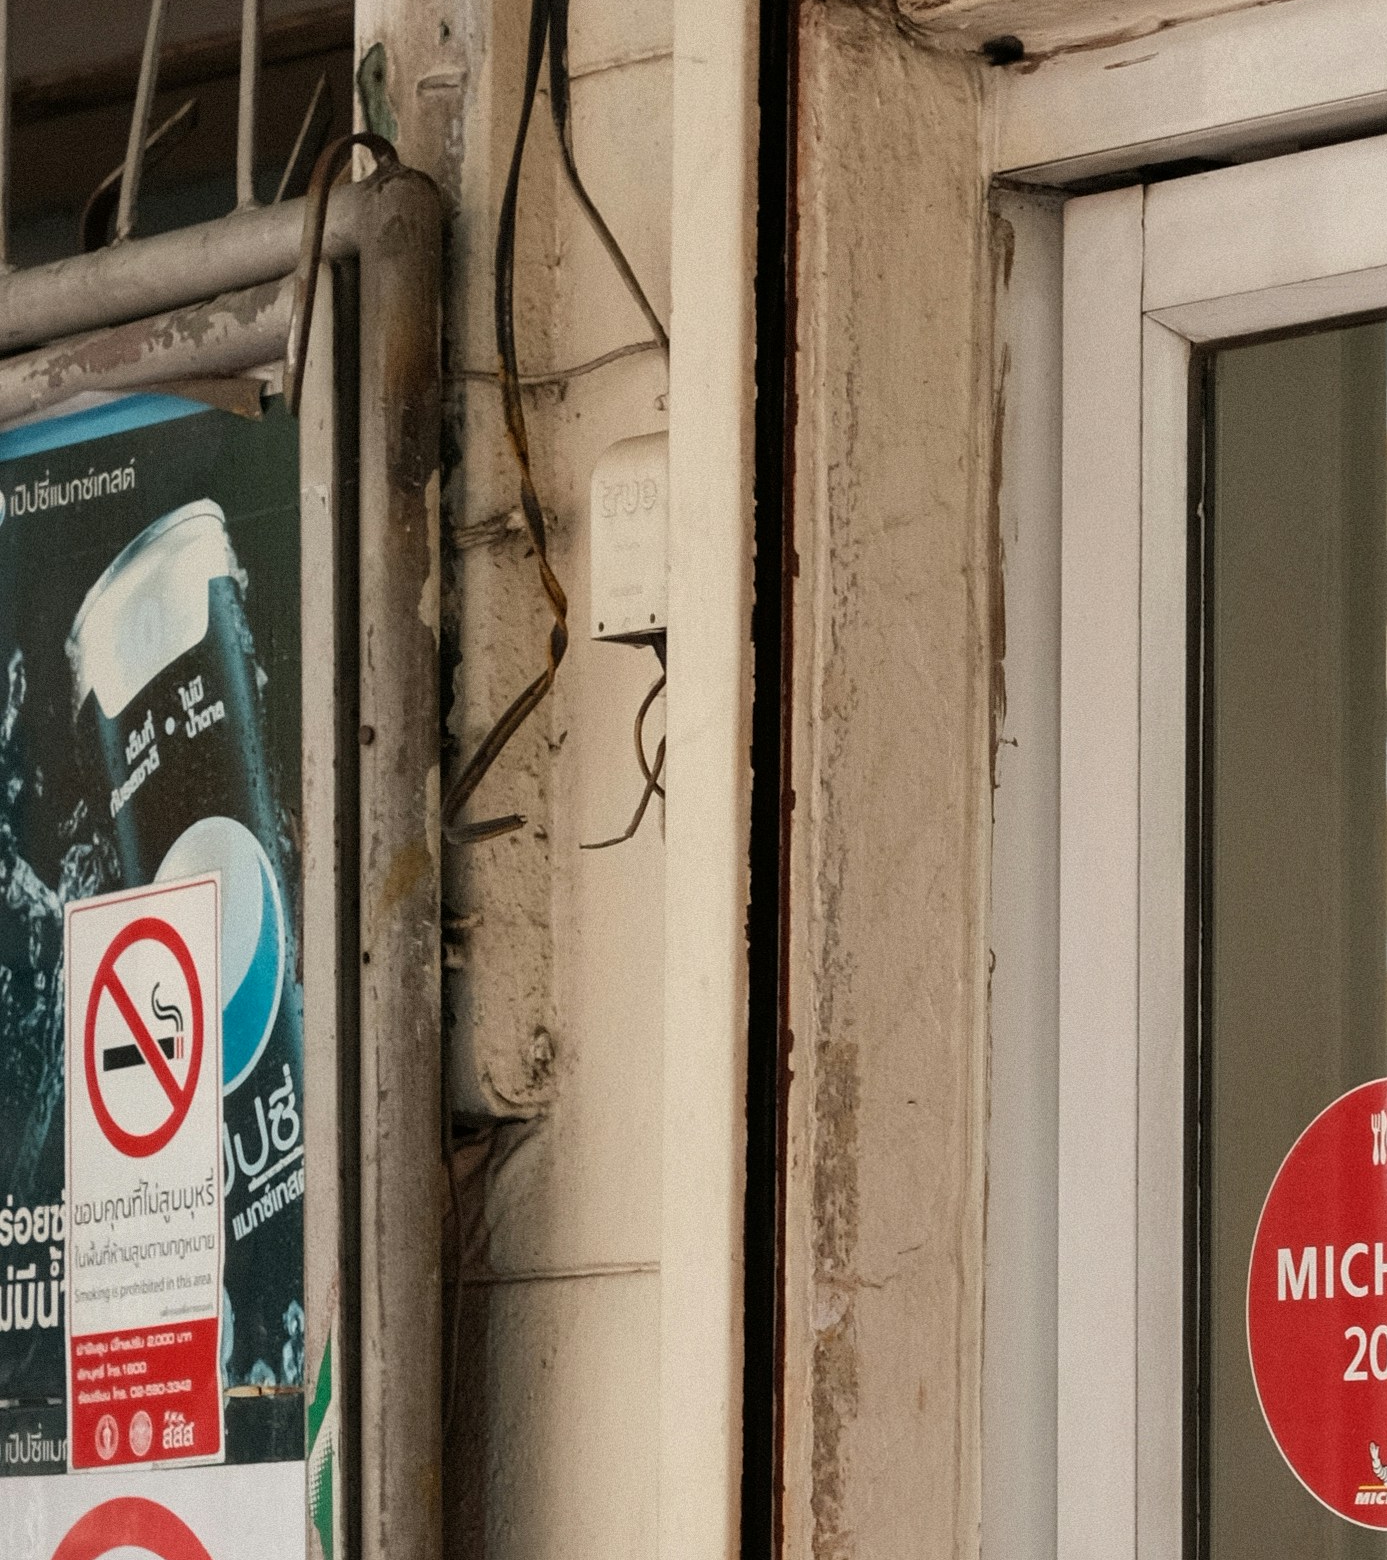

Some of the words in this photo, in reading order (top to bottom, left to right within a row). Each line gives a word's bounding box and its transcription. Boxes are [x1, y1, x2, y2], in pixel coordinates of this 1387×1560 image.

[74, 1168, 216, 1230] ขอบคุณที่ไม่สูบบุหรี่
